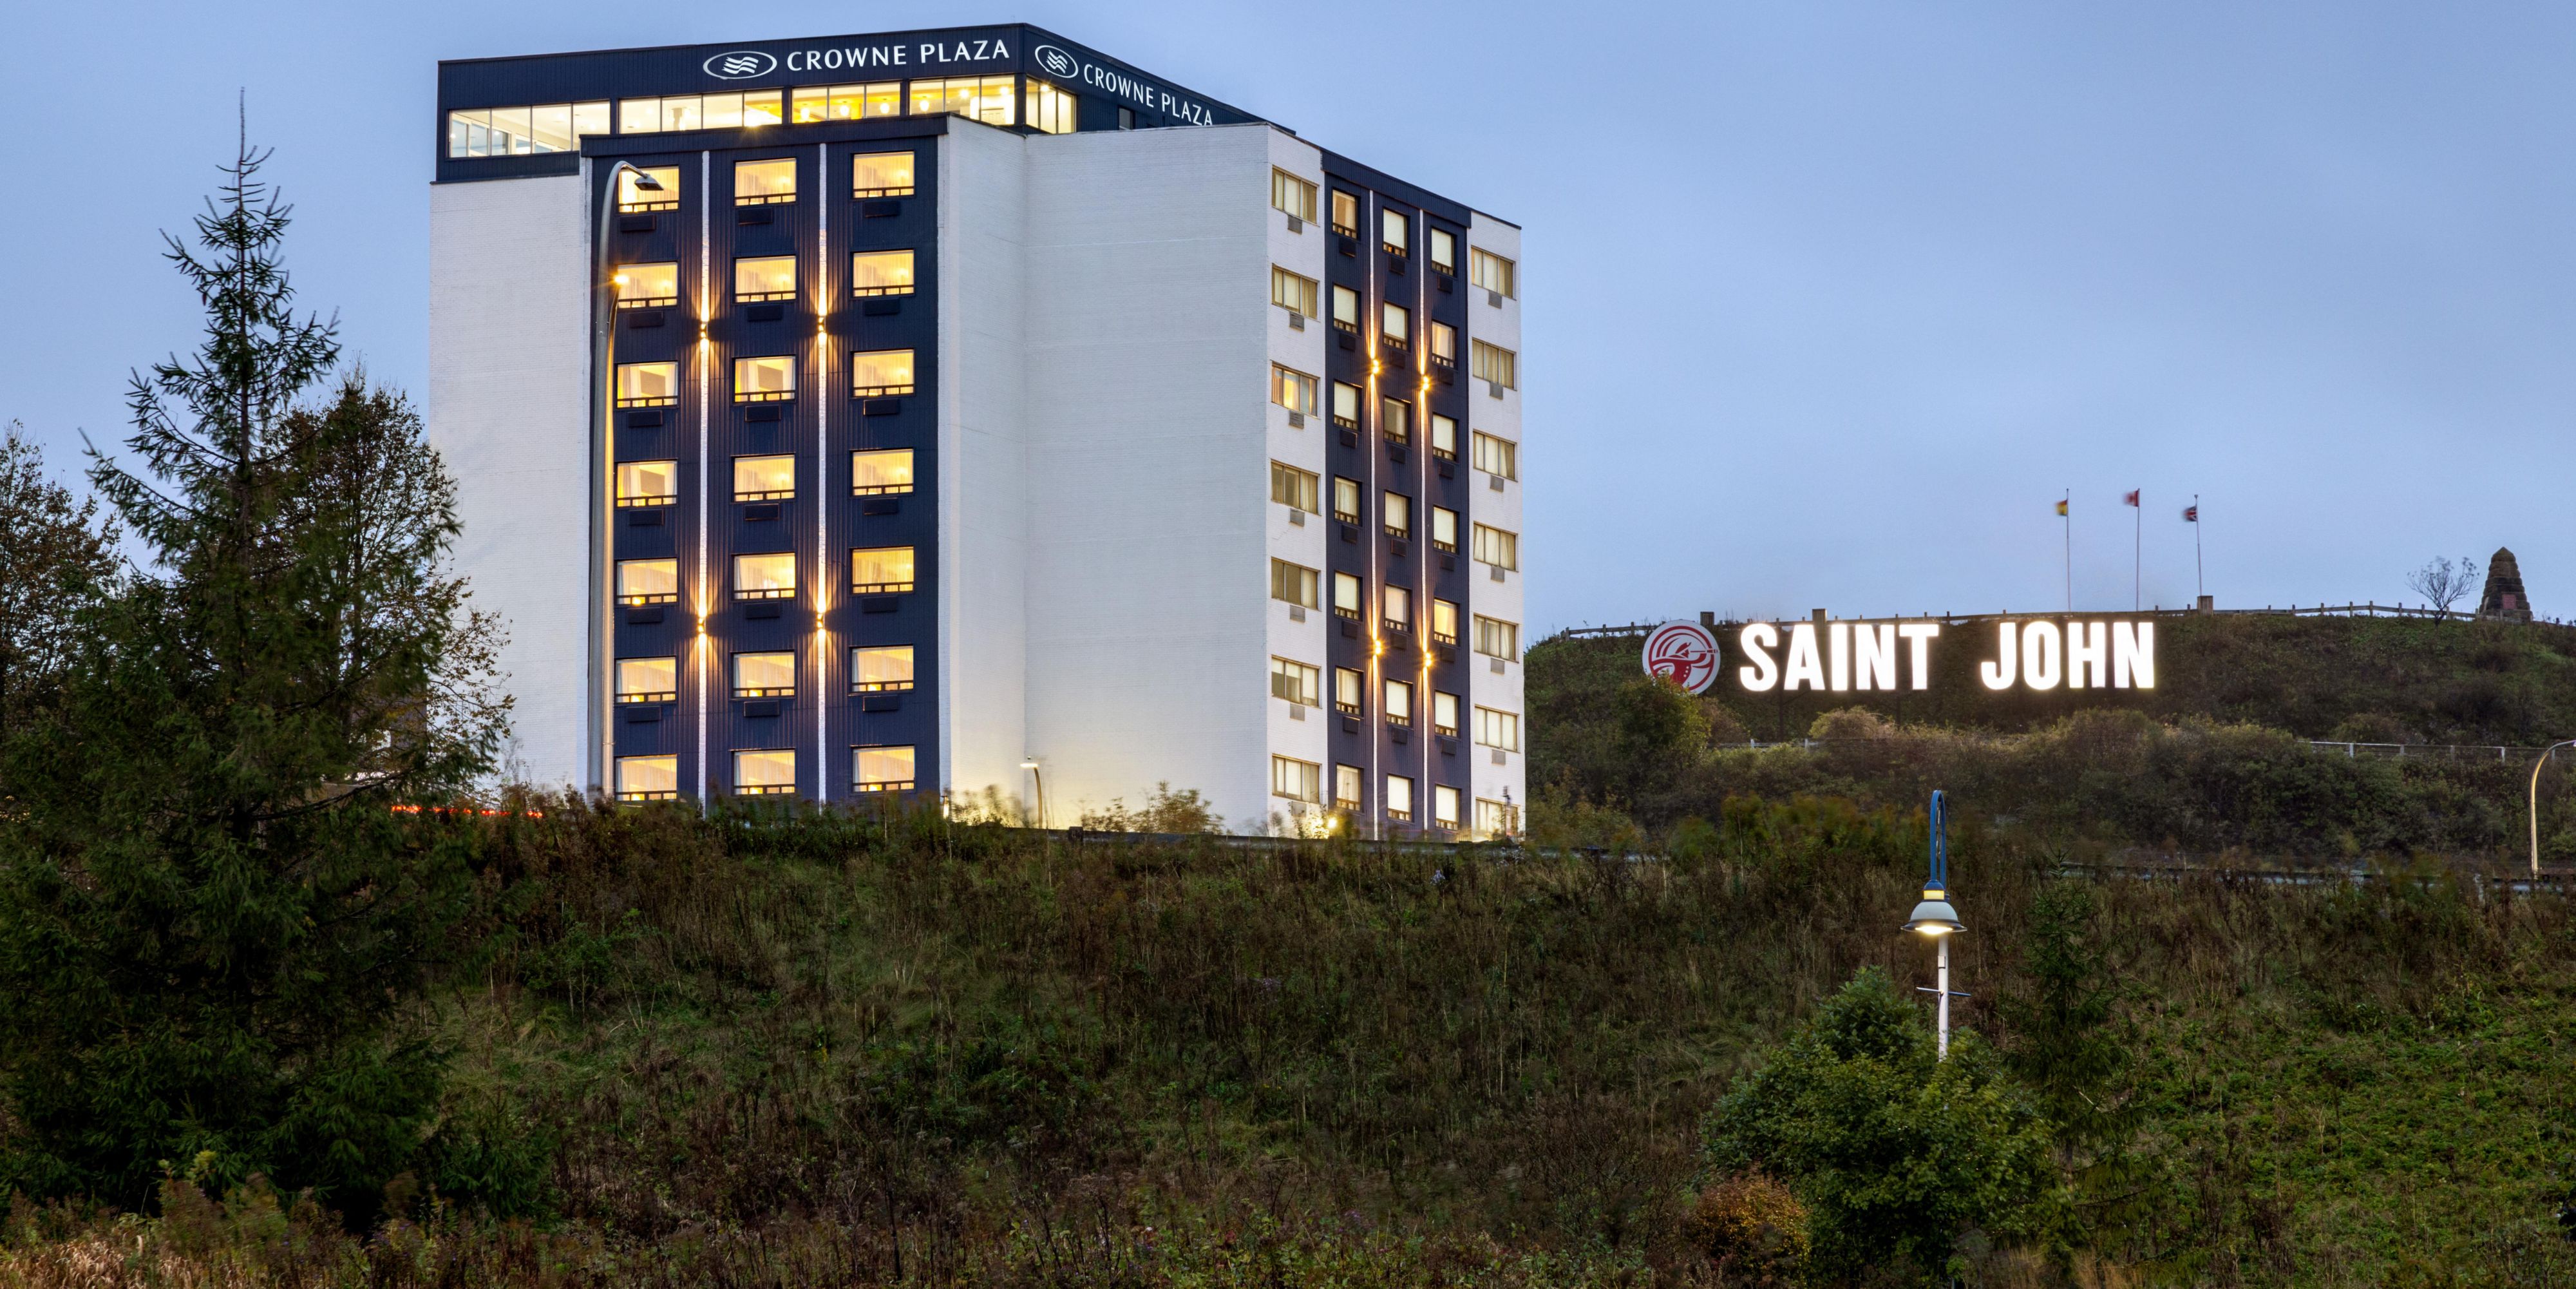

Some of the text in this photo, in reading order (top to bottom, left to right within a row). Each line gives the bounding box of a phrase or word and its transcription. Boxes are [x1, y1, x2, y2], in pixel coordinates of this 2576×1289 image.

[787, 39, 1010, 72] CROWNE PLAZA
[1084, 64, 1213, 126] CROWNE PLAZA
[1739, 622, 2154, 691] SAINT JOHN
